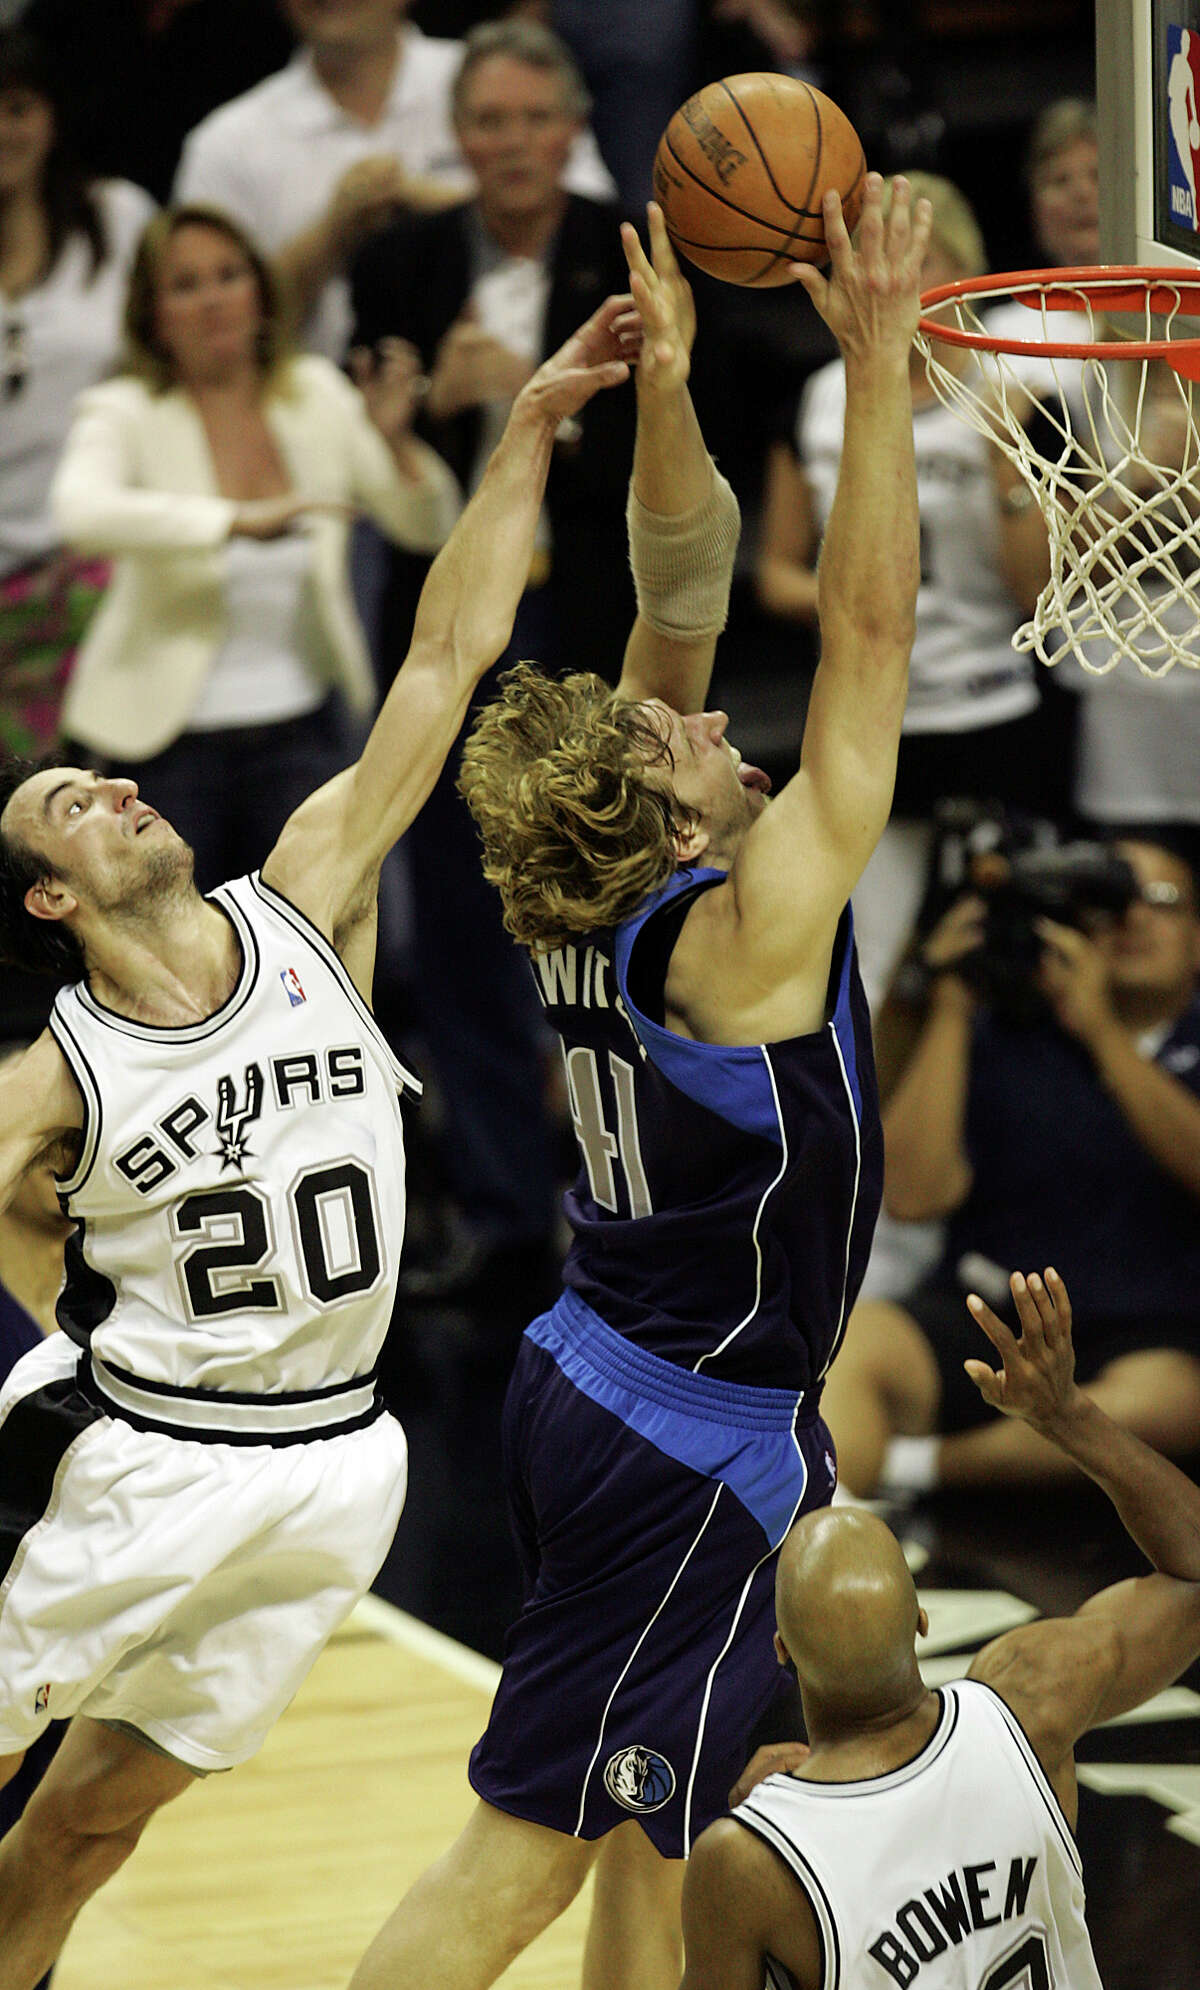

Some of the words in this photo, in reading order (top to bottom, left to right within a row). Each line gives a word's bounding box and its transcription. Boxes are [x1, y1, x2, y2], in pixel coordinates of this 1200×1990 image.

[1171, 184, 1193, 219] NBA
[112, 1045, 368, 1198] SPURS
[560, 1034, 653, 1220] 41
[167, 1154, 388, 1326] 20
[867, 1856, 1038, 1990] BOWEN
